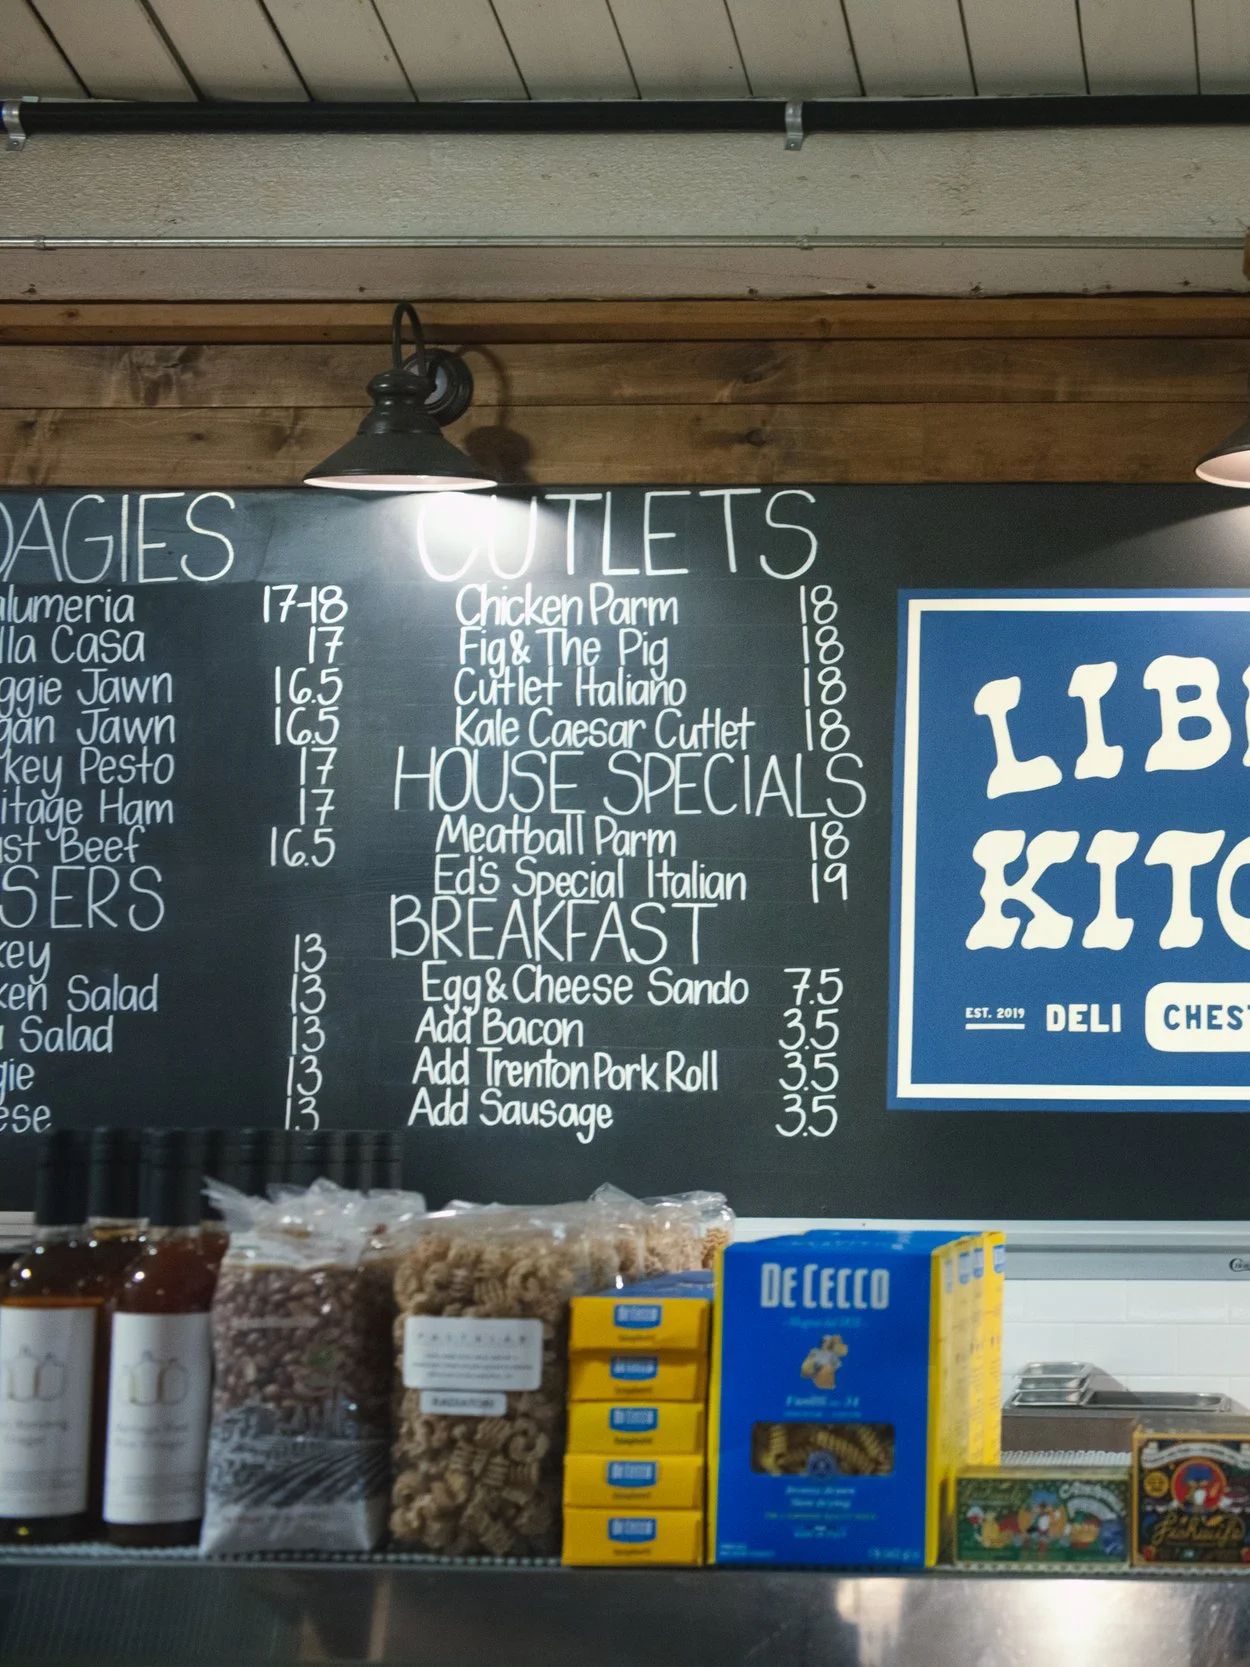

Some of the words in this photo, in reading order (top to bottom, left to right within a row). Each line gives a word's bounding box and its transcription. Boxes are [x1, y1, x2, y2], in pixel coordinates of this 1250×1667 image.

[0, 492, 236, 583] AGIES
[417, 487, 818, 582] CUTLETS
[263, 584, 349, 624] 17-18
[456, 583, 583, 626] Chicken
[590, 582, 679, 625] Parm
[800, 585, 838, 625] 18
[51, 624, 145, 664] Casa
[308, 626, 345, 664] 17
[537, 628, 601, 666] The
[619, 628, 669, 680] Pig
[802, 625, 845, 664] 18
[76, 668, 173, 706] Jawn
[275, 666, 344, 706] 16.5
[454, 666, 563, 706] Cutlet
[575, 667, 687, 707] Italiano
[804, 666, 847, 706] 18
[76, 708, 175, 745] Jawn
[275, 707, 340, 746] 16.5
[455, 707, 520, 747] Kale
[528, 706, 647, 748] Caesar
[655, 707, 756, 750] Cutlet
[806, 707, 850, 751] 18
[0, 747, 62, 800] key
[79, 747, 175, 785] Pesto
[300, 747, 338, 785] 17
[394, 746, 586, 815] HOUSE
[603, 750, 867, 818] SPECIALS
[1, 786, 83, 839] itage
[100, 788, 174, 825] Ham
[300, 788, 335, 826] 17
[0, 825, 41, 863] st
[59, 826, 146, 863] Beef
[270, 827, 336, 867] 16.5
[435, 814, 584, 855] Meatball
[594, 816, 677, 857] Parm
[810, 820, 850, 861] 18
[434, 853, 500, 896] Ed's
[512, 856, 624, 906] Special
[648, 858, 747, 900] Italian
[811, 862, 848, 904] 19
[390, 894, 718, 965] BREAKFAST
[294, 933, 327, 973] 13
[67, 973, 159, 1012] Salad
[291, 973, 327, 1014] 13
[513, 963, 633, 1005] Cheese
[647, 966, 749, 1006] Sando
[783, 968, 844, 1006] 7.5
[19, 1014, 114, 1053] Salad
[414, 1006, 472, 1044] Add
[482, 1007, 584, 1048] Bacon
[778, 1008, 839, 1051] 3.5
[965, 1007, 992, 1019] EST.
[996, 1007, 1025, 1019] 2019
[1046, 1003, 1121, 1033] DELI
[291, 1015, 326, 1055] 13
[286, 1055, 323, 1096] 13
[412, 1046, 470, 1086] Add
[476, 1047, 588, 1090] Trenton
[594, 1052, 659, 1090] Pork
[666, 1049, 718, 1092] Roll
[778, 1051, 839, 1093] 3.5
[284, 1097, 320, 1131] 13
[407, 1087, 468, 1127] Add
[479, 1087, 614, 1144] Sausage
[775, 1094, 838, 1137] 3.5
